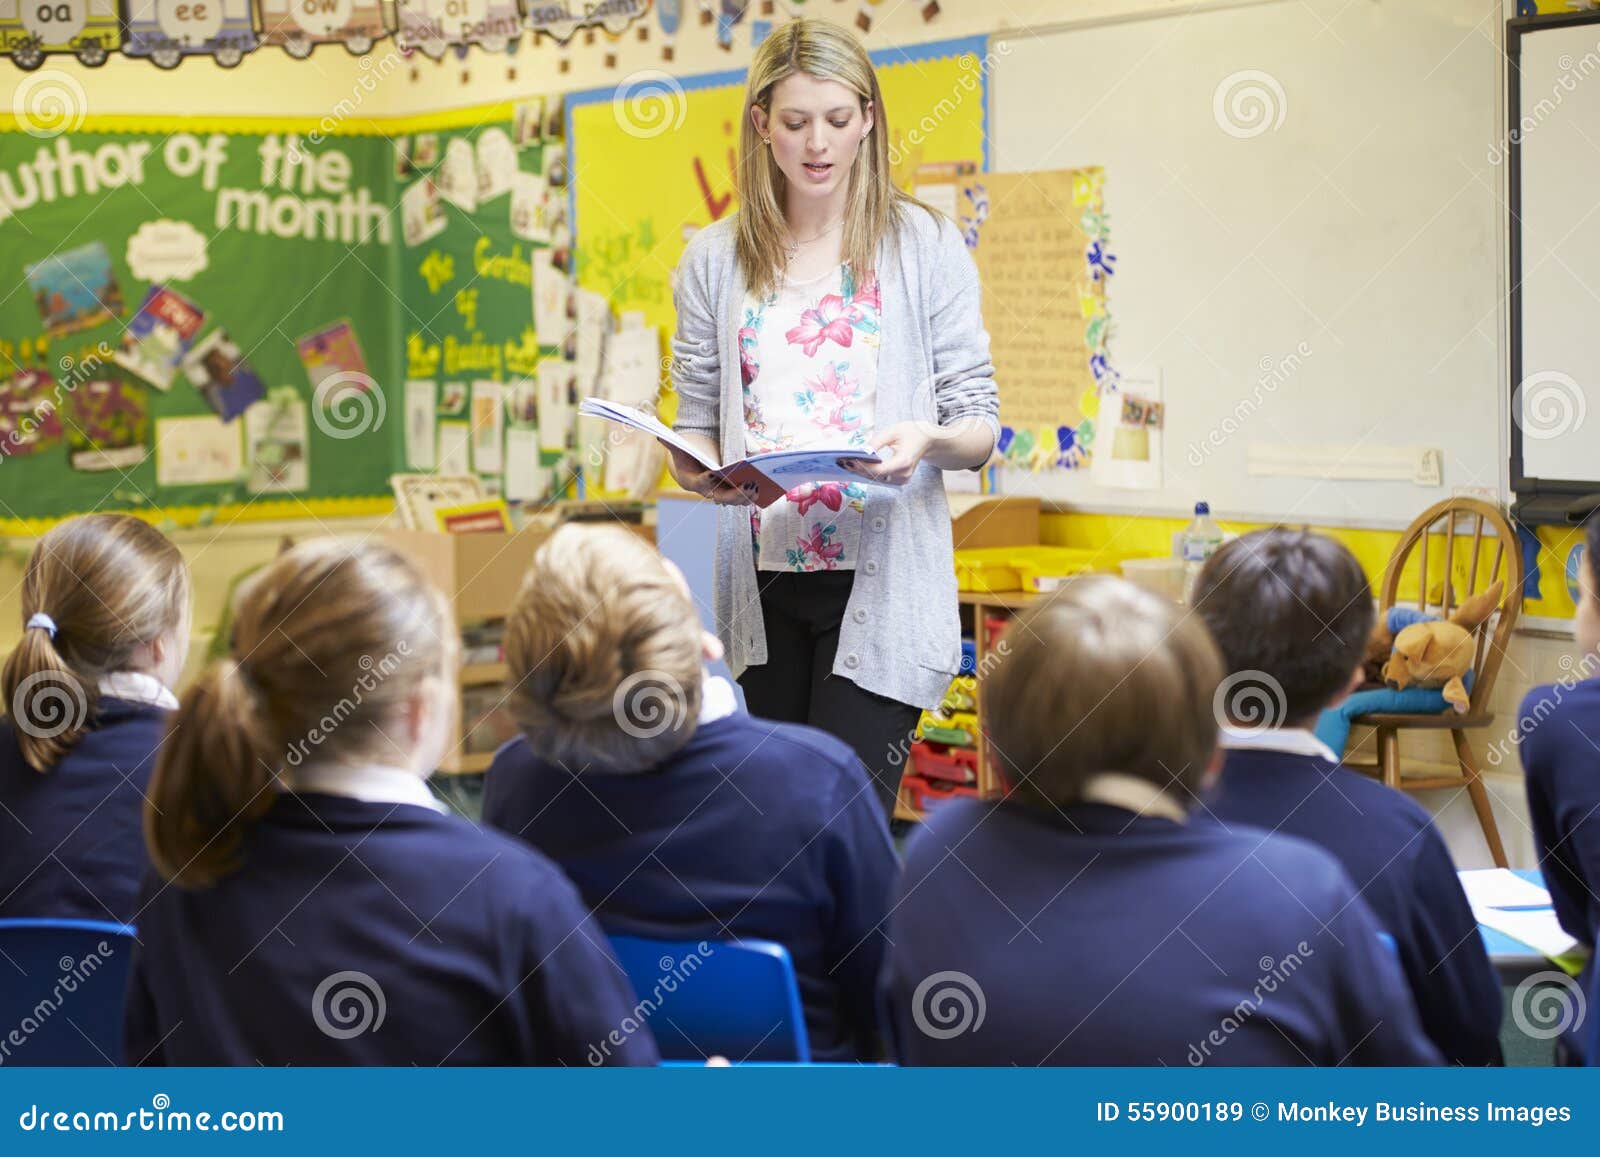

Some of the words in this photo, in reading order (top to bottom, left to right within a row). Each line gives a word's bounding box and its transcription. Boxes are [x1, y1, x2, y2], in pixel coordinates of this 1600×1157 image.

[37, 4, 72, 23] oa
[175, 4, 208, 22] ee
[0, 136, 151, 223] uthor
[163, 133, 230, 192] of
[258, 132, 353, 195] the
[215, 186, 393, 245] month
